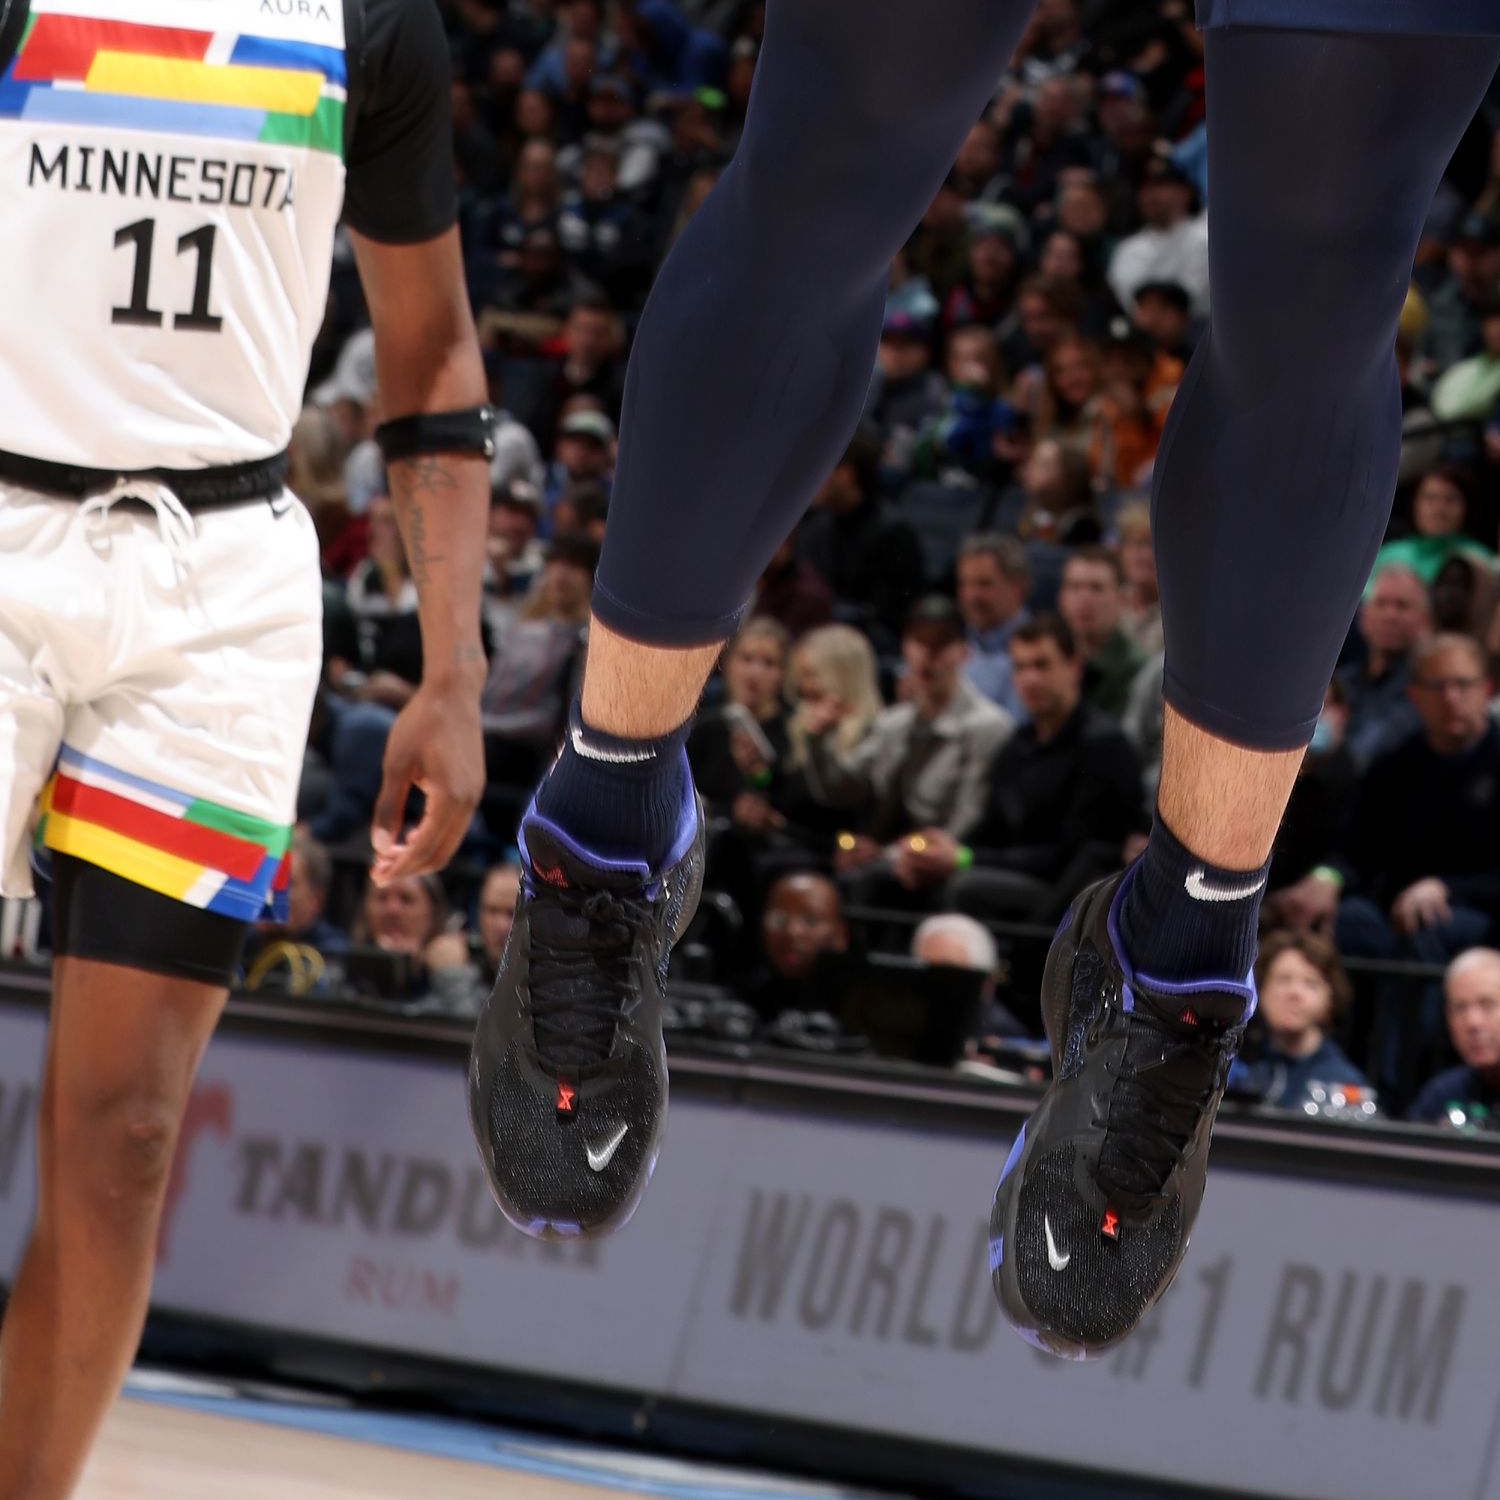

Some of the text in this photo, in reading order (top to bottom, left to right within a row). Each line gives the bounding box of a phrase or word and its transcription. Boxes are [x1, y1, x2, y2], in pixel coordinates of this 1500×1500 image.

[111, 217, 223, 333] 11
[345, 1255, 462, 1316] RUM
[1252, 1260, 1468, 1425] RUM
